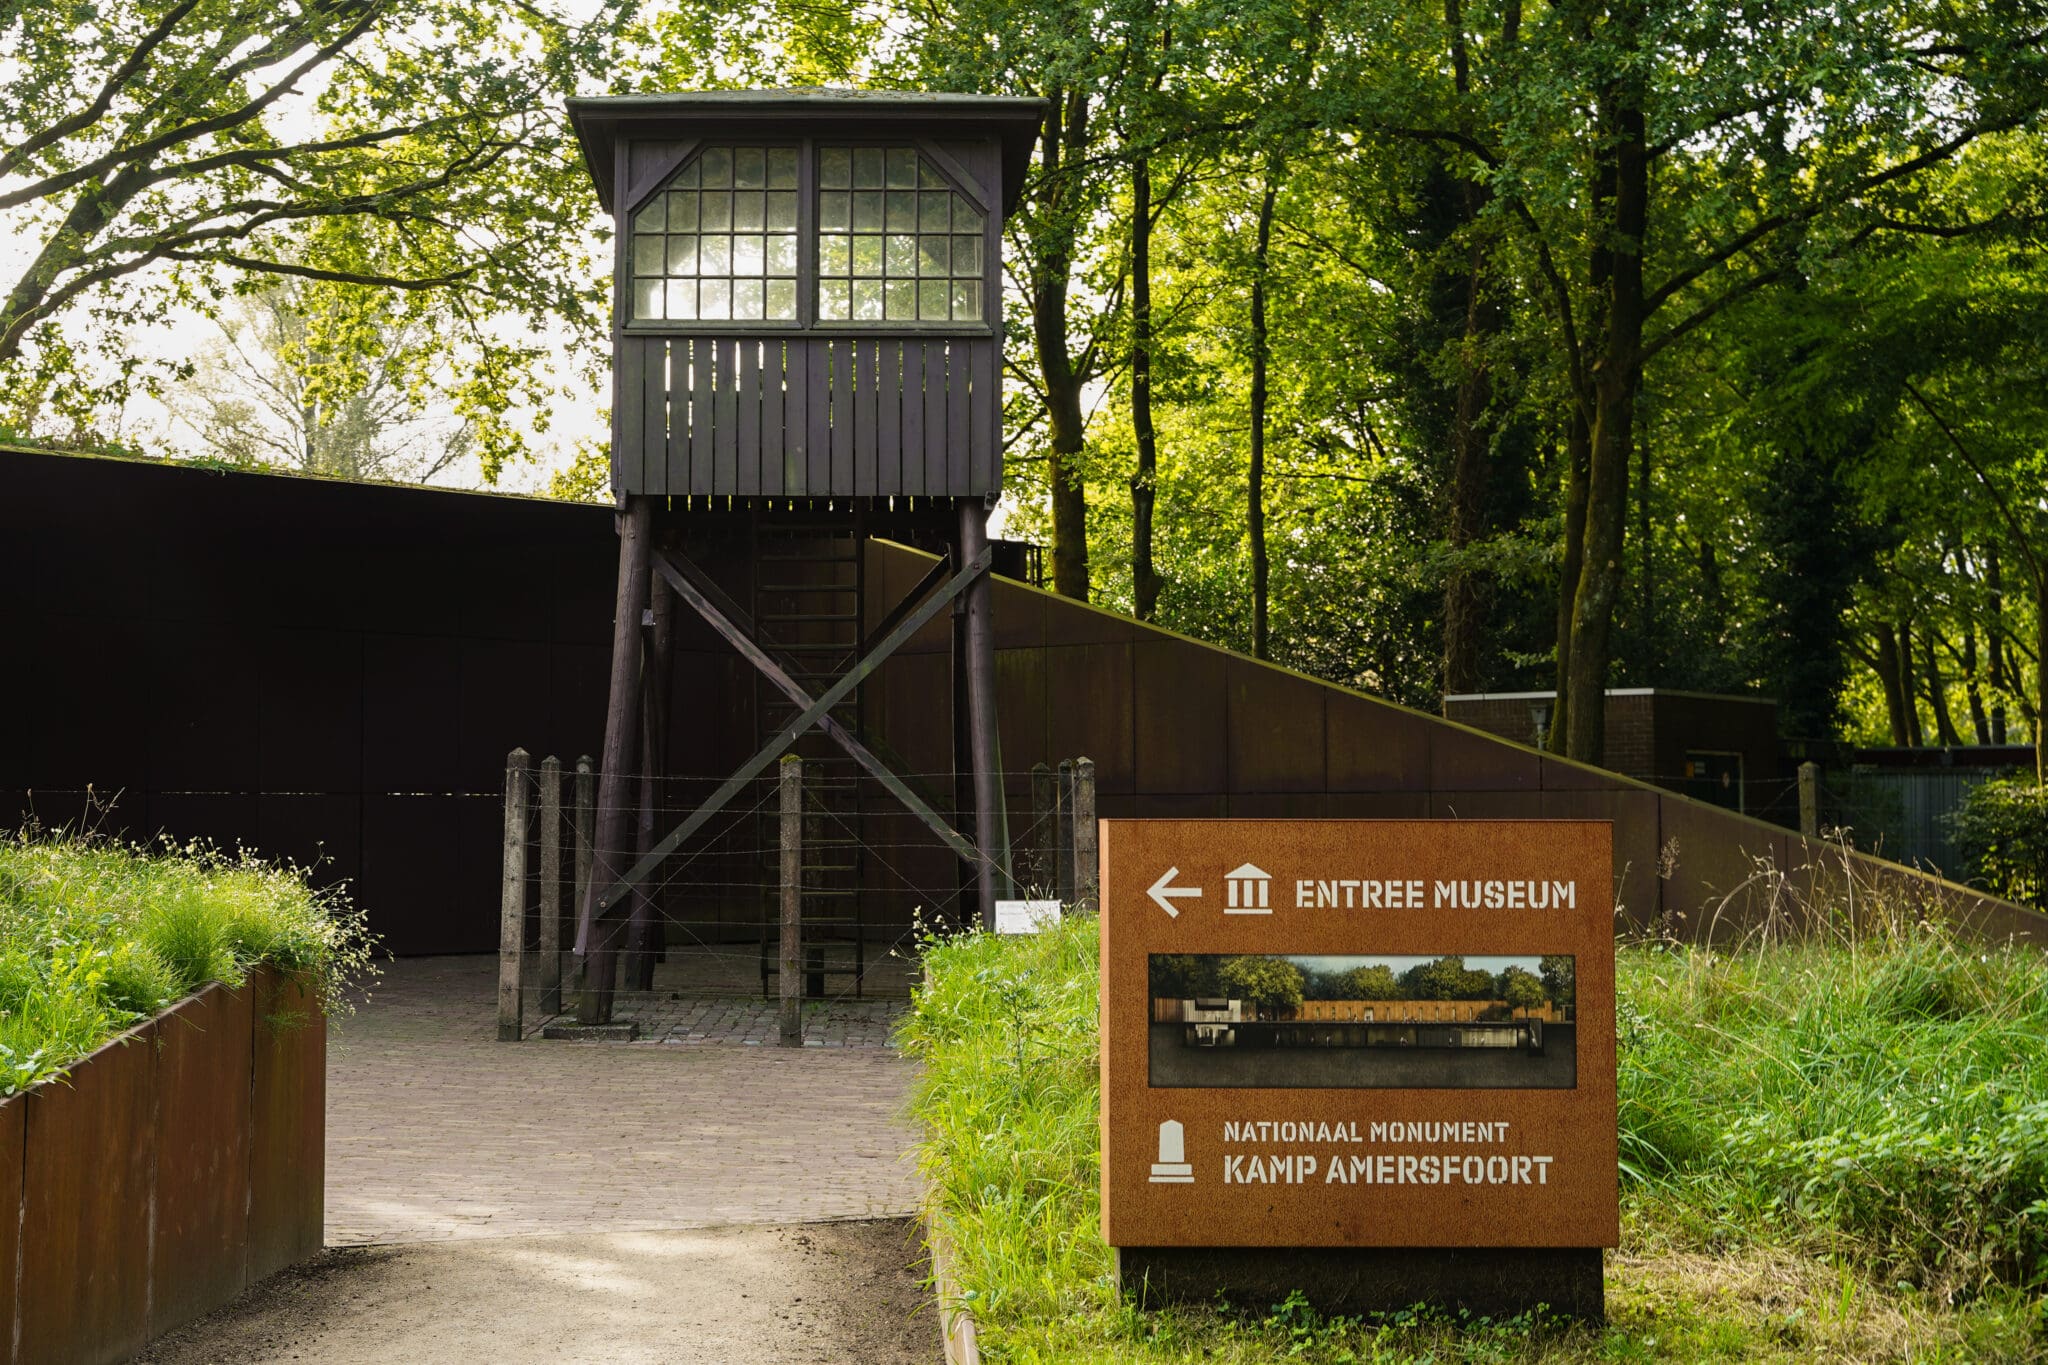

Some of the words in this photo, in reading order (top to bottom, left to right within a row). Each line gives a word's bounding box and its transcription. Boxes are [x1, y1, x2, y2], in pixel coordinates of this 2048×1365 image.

[1296, 880, 1424, 909] ENTREE
[1434, 880, 1576, 909] MUSEUM
[1224, 1121, 1363, 1143] NATIONAAL
[1370, 1121, 1510, 1143] MONUMENT
[1224, 1155, 1317, 1184] KAMP
[1325, 1155, 1554, 1184] AMERSFOORT
